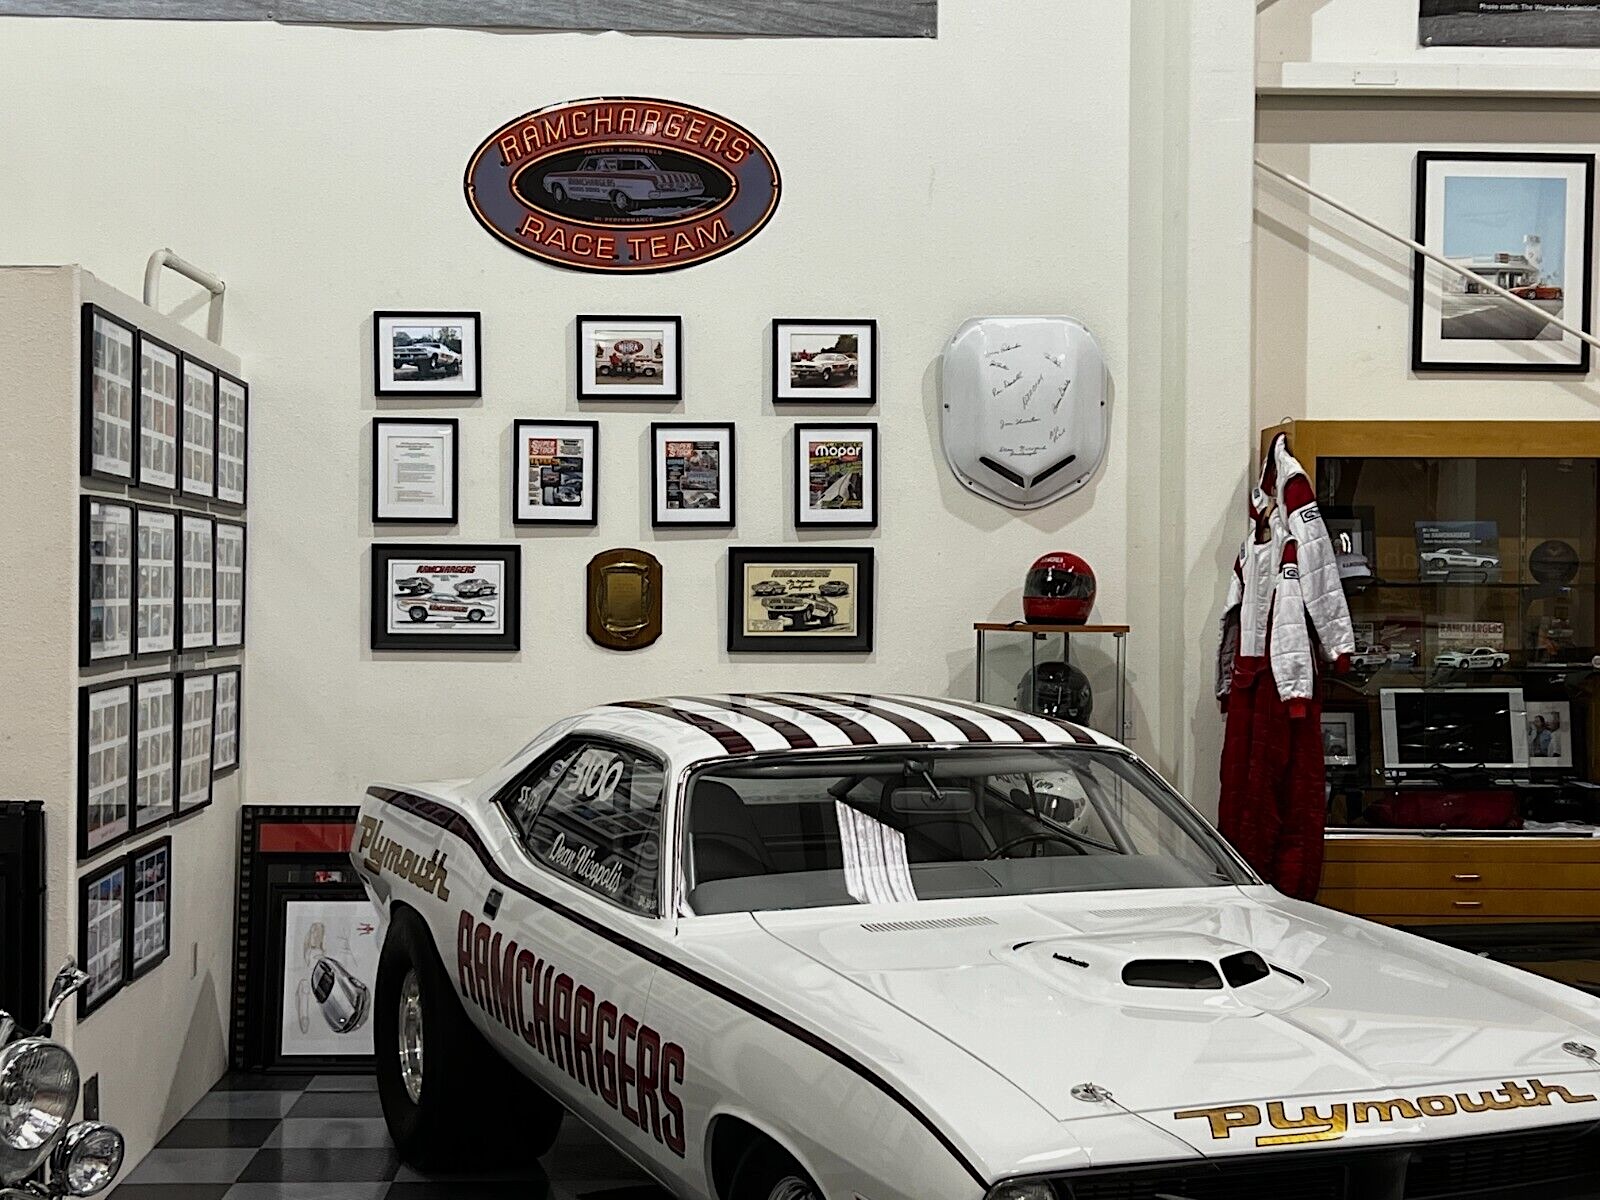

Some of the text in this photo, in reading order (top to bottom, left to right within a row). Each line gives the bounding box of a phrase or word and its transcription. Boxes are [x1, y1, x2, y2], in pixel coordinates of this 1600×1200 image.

[499, 107, 751, 165] RAMCHARGERS
[520, 215, 732, 260] RACE TEAM
[1440, 623, 1504, 634] RAMCHARGERS
[359, 815, 451, 902] Plymouth
[457, 909, 686, 1159] RAMCHARGERS
[1174, 1079, 1598, 1147] Plymouth
